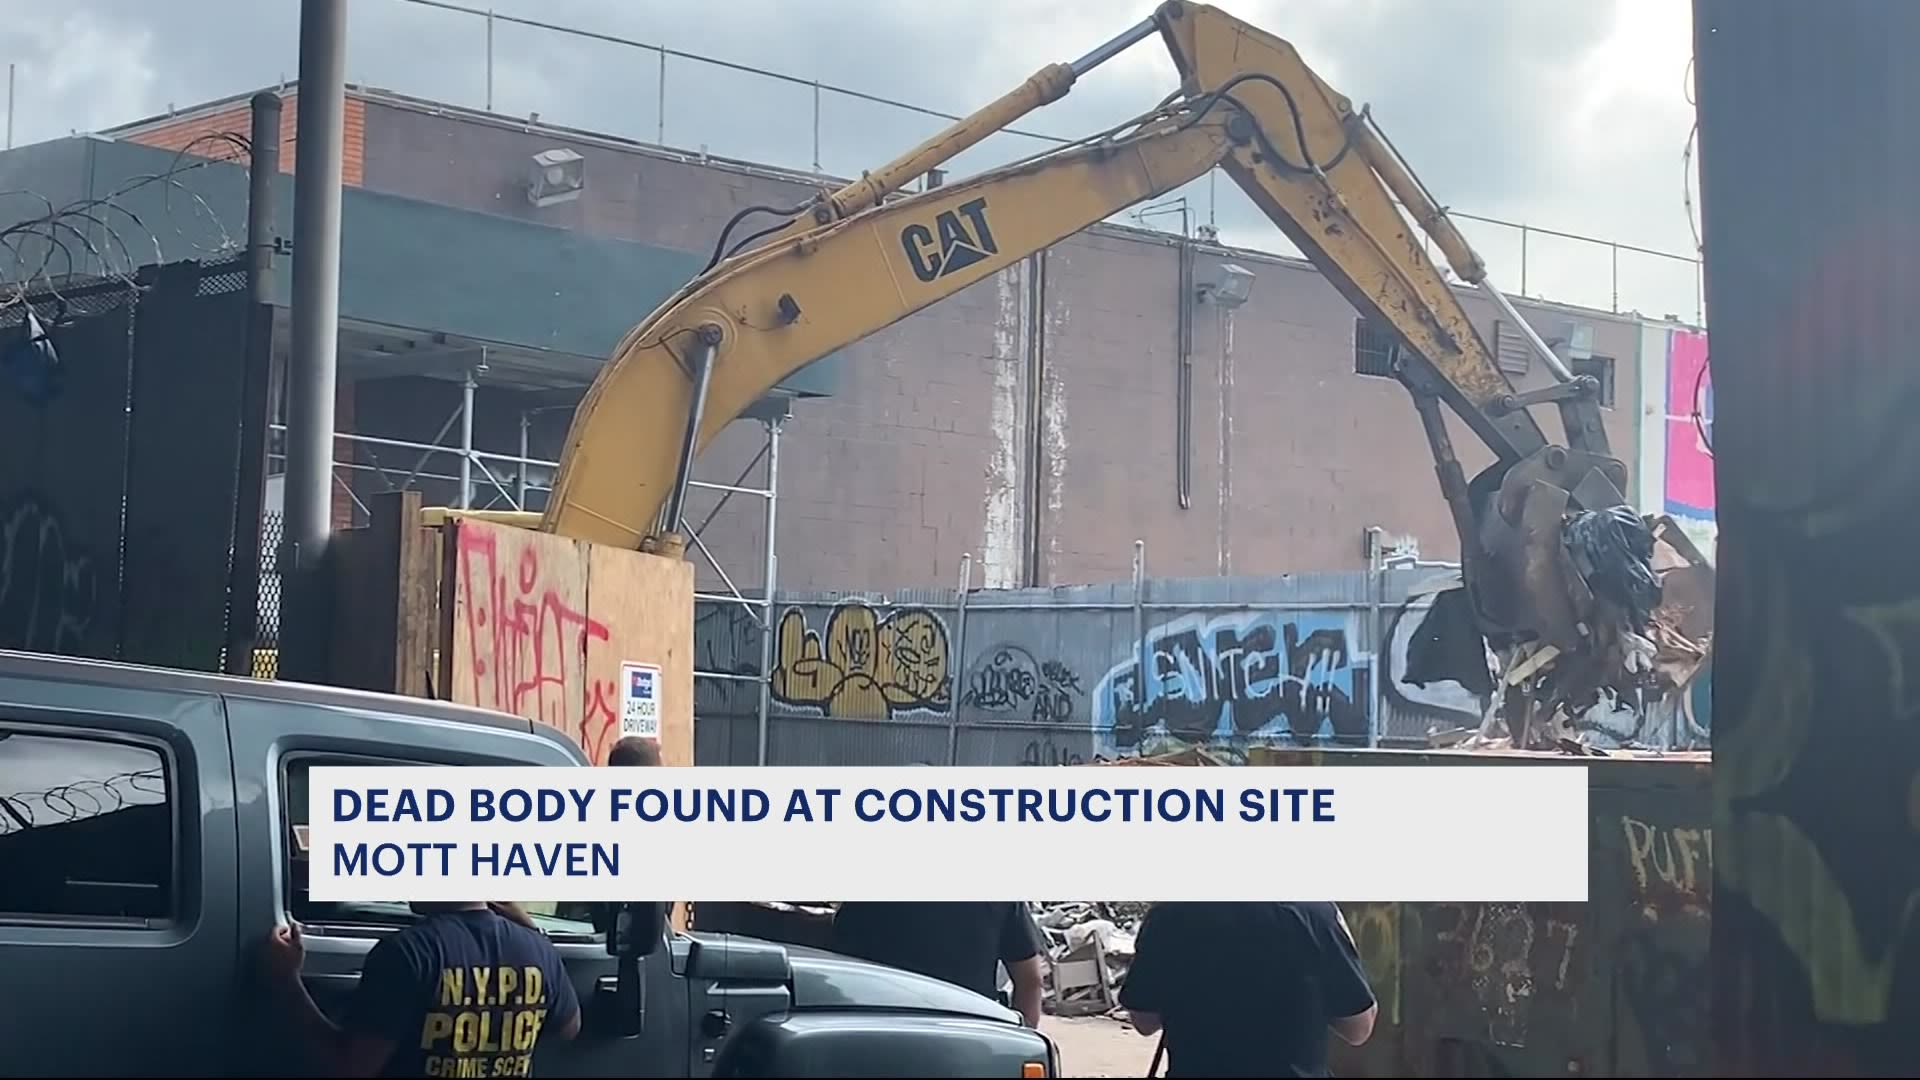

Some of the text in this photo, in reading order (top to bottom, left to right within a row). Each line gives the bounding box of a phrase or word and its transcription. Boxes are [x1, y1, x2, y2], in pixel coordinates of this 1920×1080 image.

[901, 196, 998, 282] CAT
[441, 966, 546, 1006] N.Y.P.D.
[421, 1009, 547, 1052] POLICE
[425, 1055, 488, 1078] CRIME
